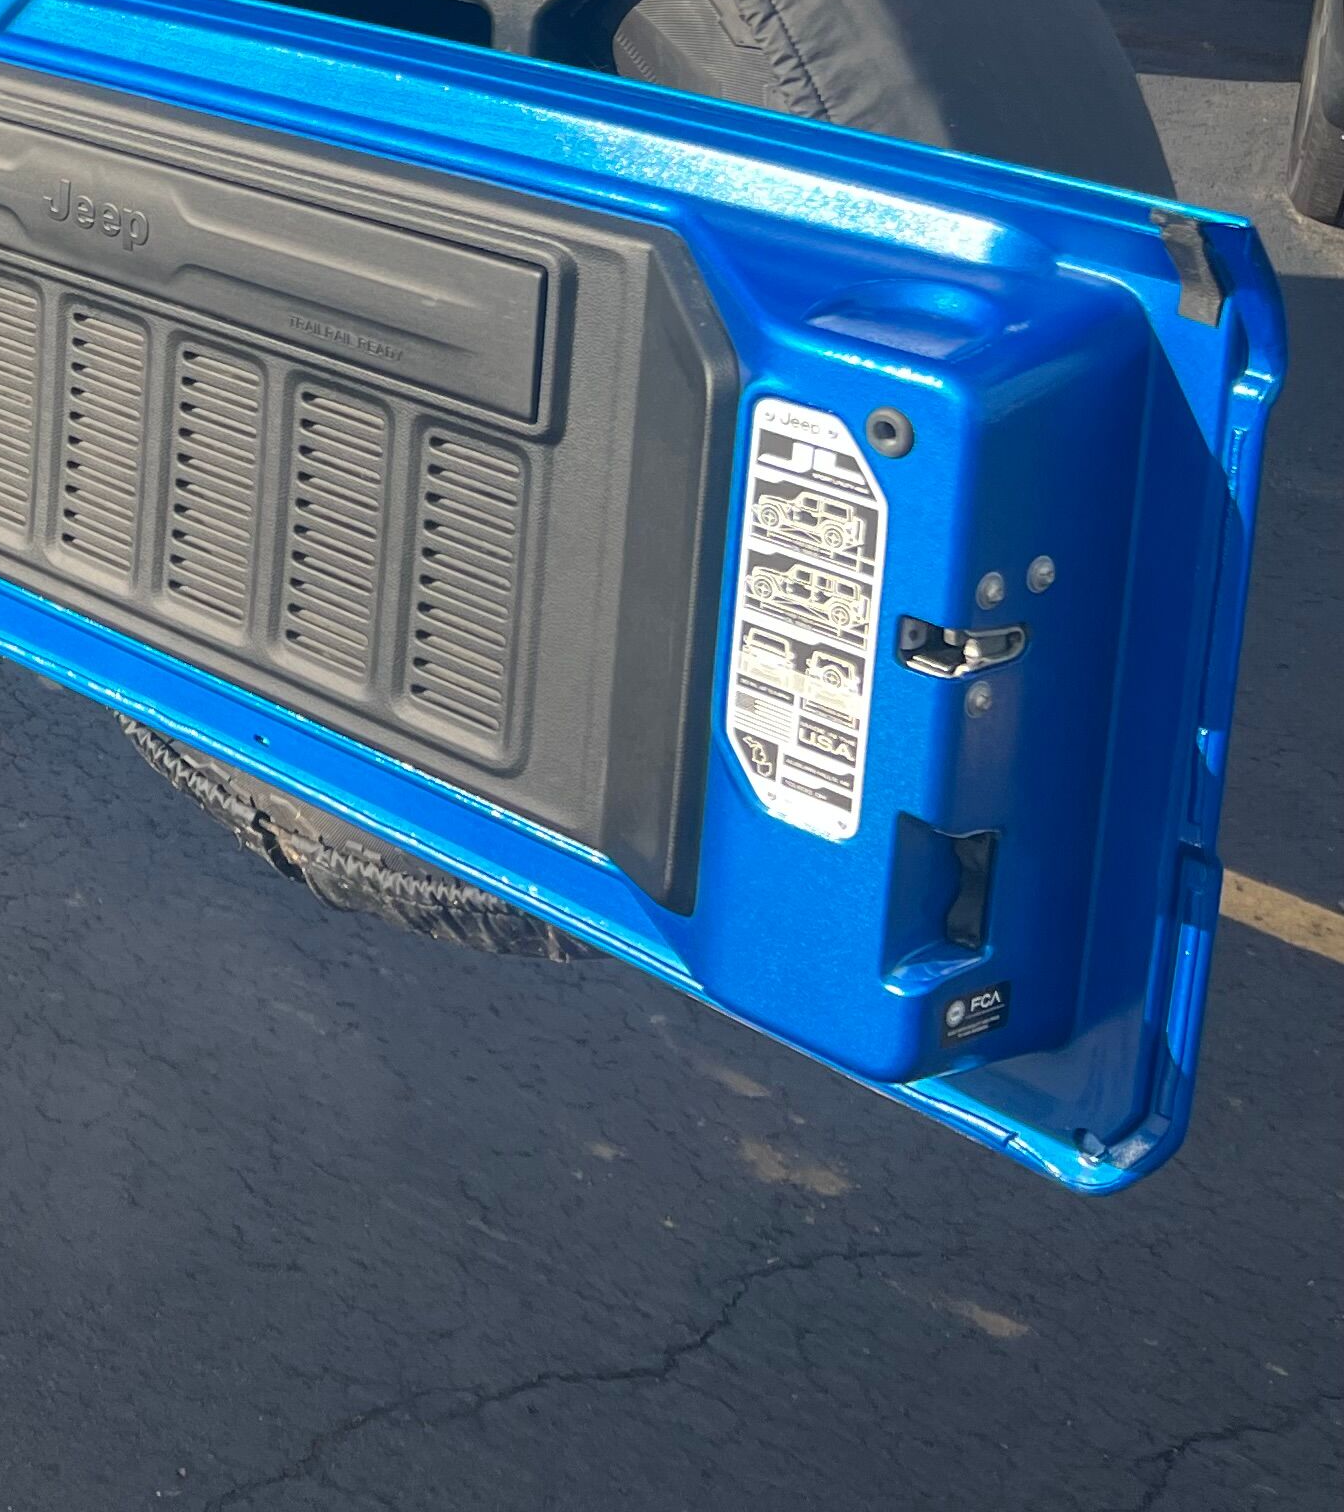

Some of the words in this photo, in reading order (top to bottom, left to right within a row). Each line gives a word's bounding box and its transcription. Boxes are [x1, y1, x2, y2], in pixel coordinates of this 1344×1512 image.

[43, 177, 150, 252] Jeep
[798, 726, 855, 761] USA
[970, 990, 1001, 1012] FCA
